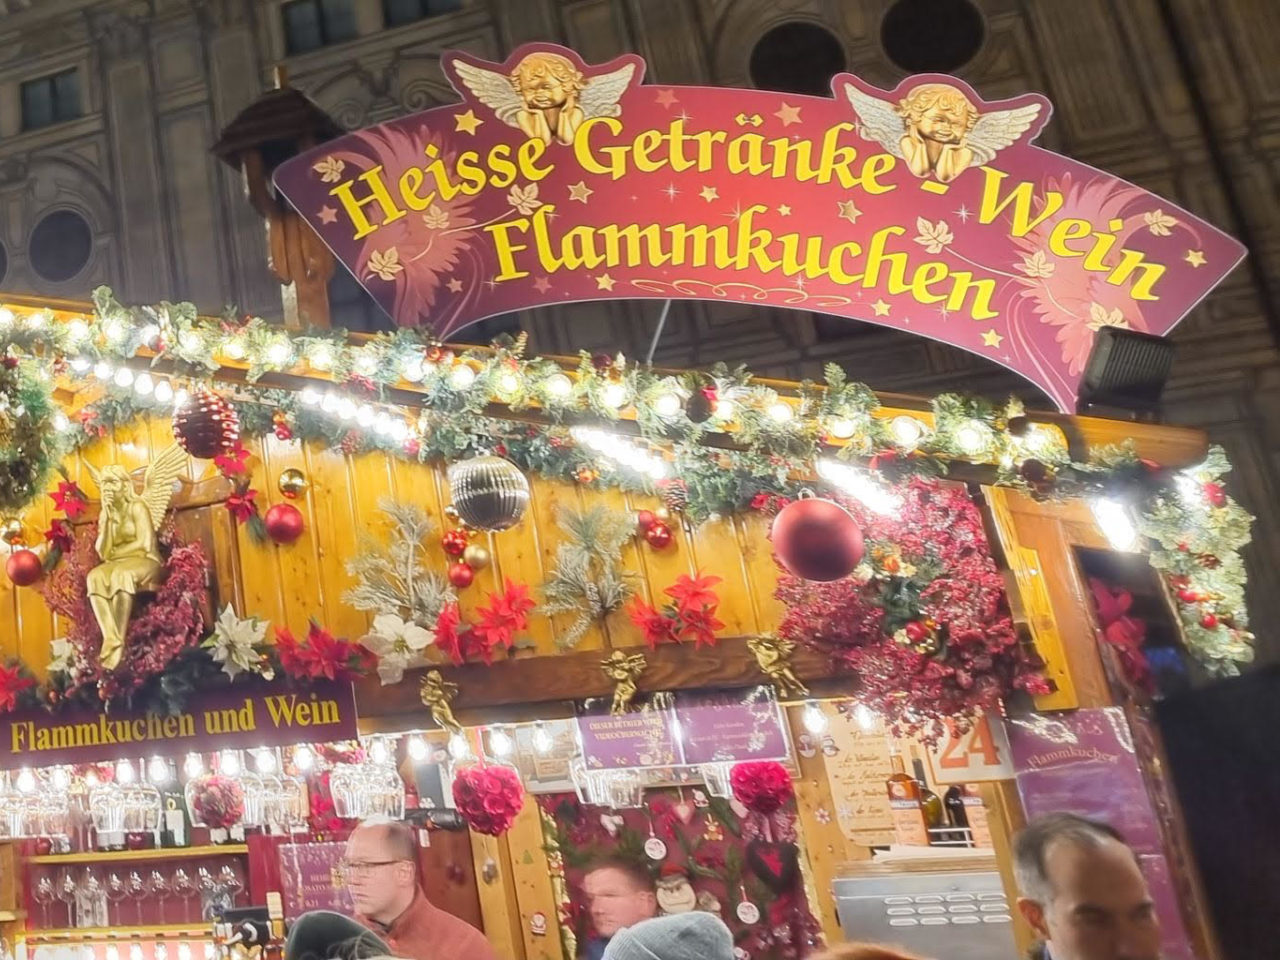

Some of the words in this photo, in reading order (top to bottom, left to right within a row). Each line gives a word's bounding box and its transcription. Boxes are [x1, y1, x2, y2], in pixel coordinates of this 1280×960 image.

[329, 137, 555, 240] Heisse
[574, 113, 897, 195] Getränke
[979, 166, 1166, 301] Wein
[483, 204, 999, 321] Flammkuchen
[10, 711, 196, 754] Flammkuchen
[204, 698, 256, 735] und
[264, 692, 341, 729] Wein
[939, 714, 1001, 769] 24
[1026, 746, 1120, 771] Flammkuchen
